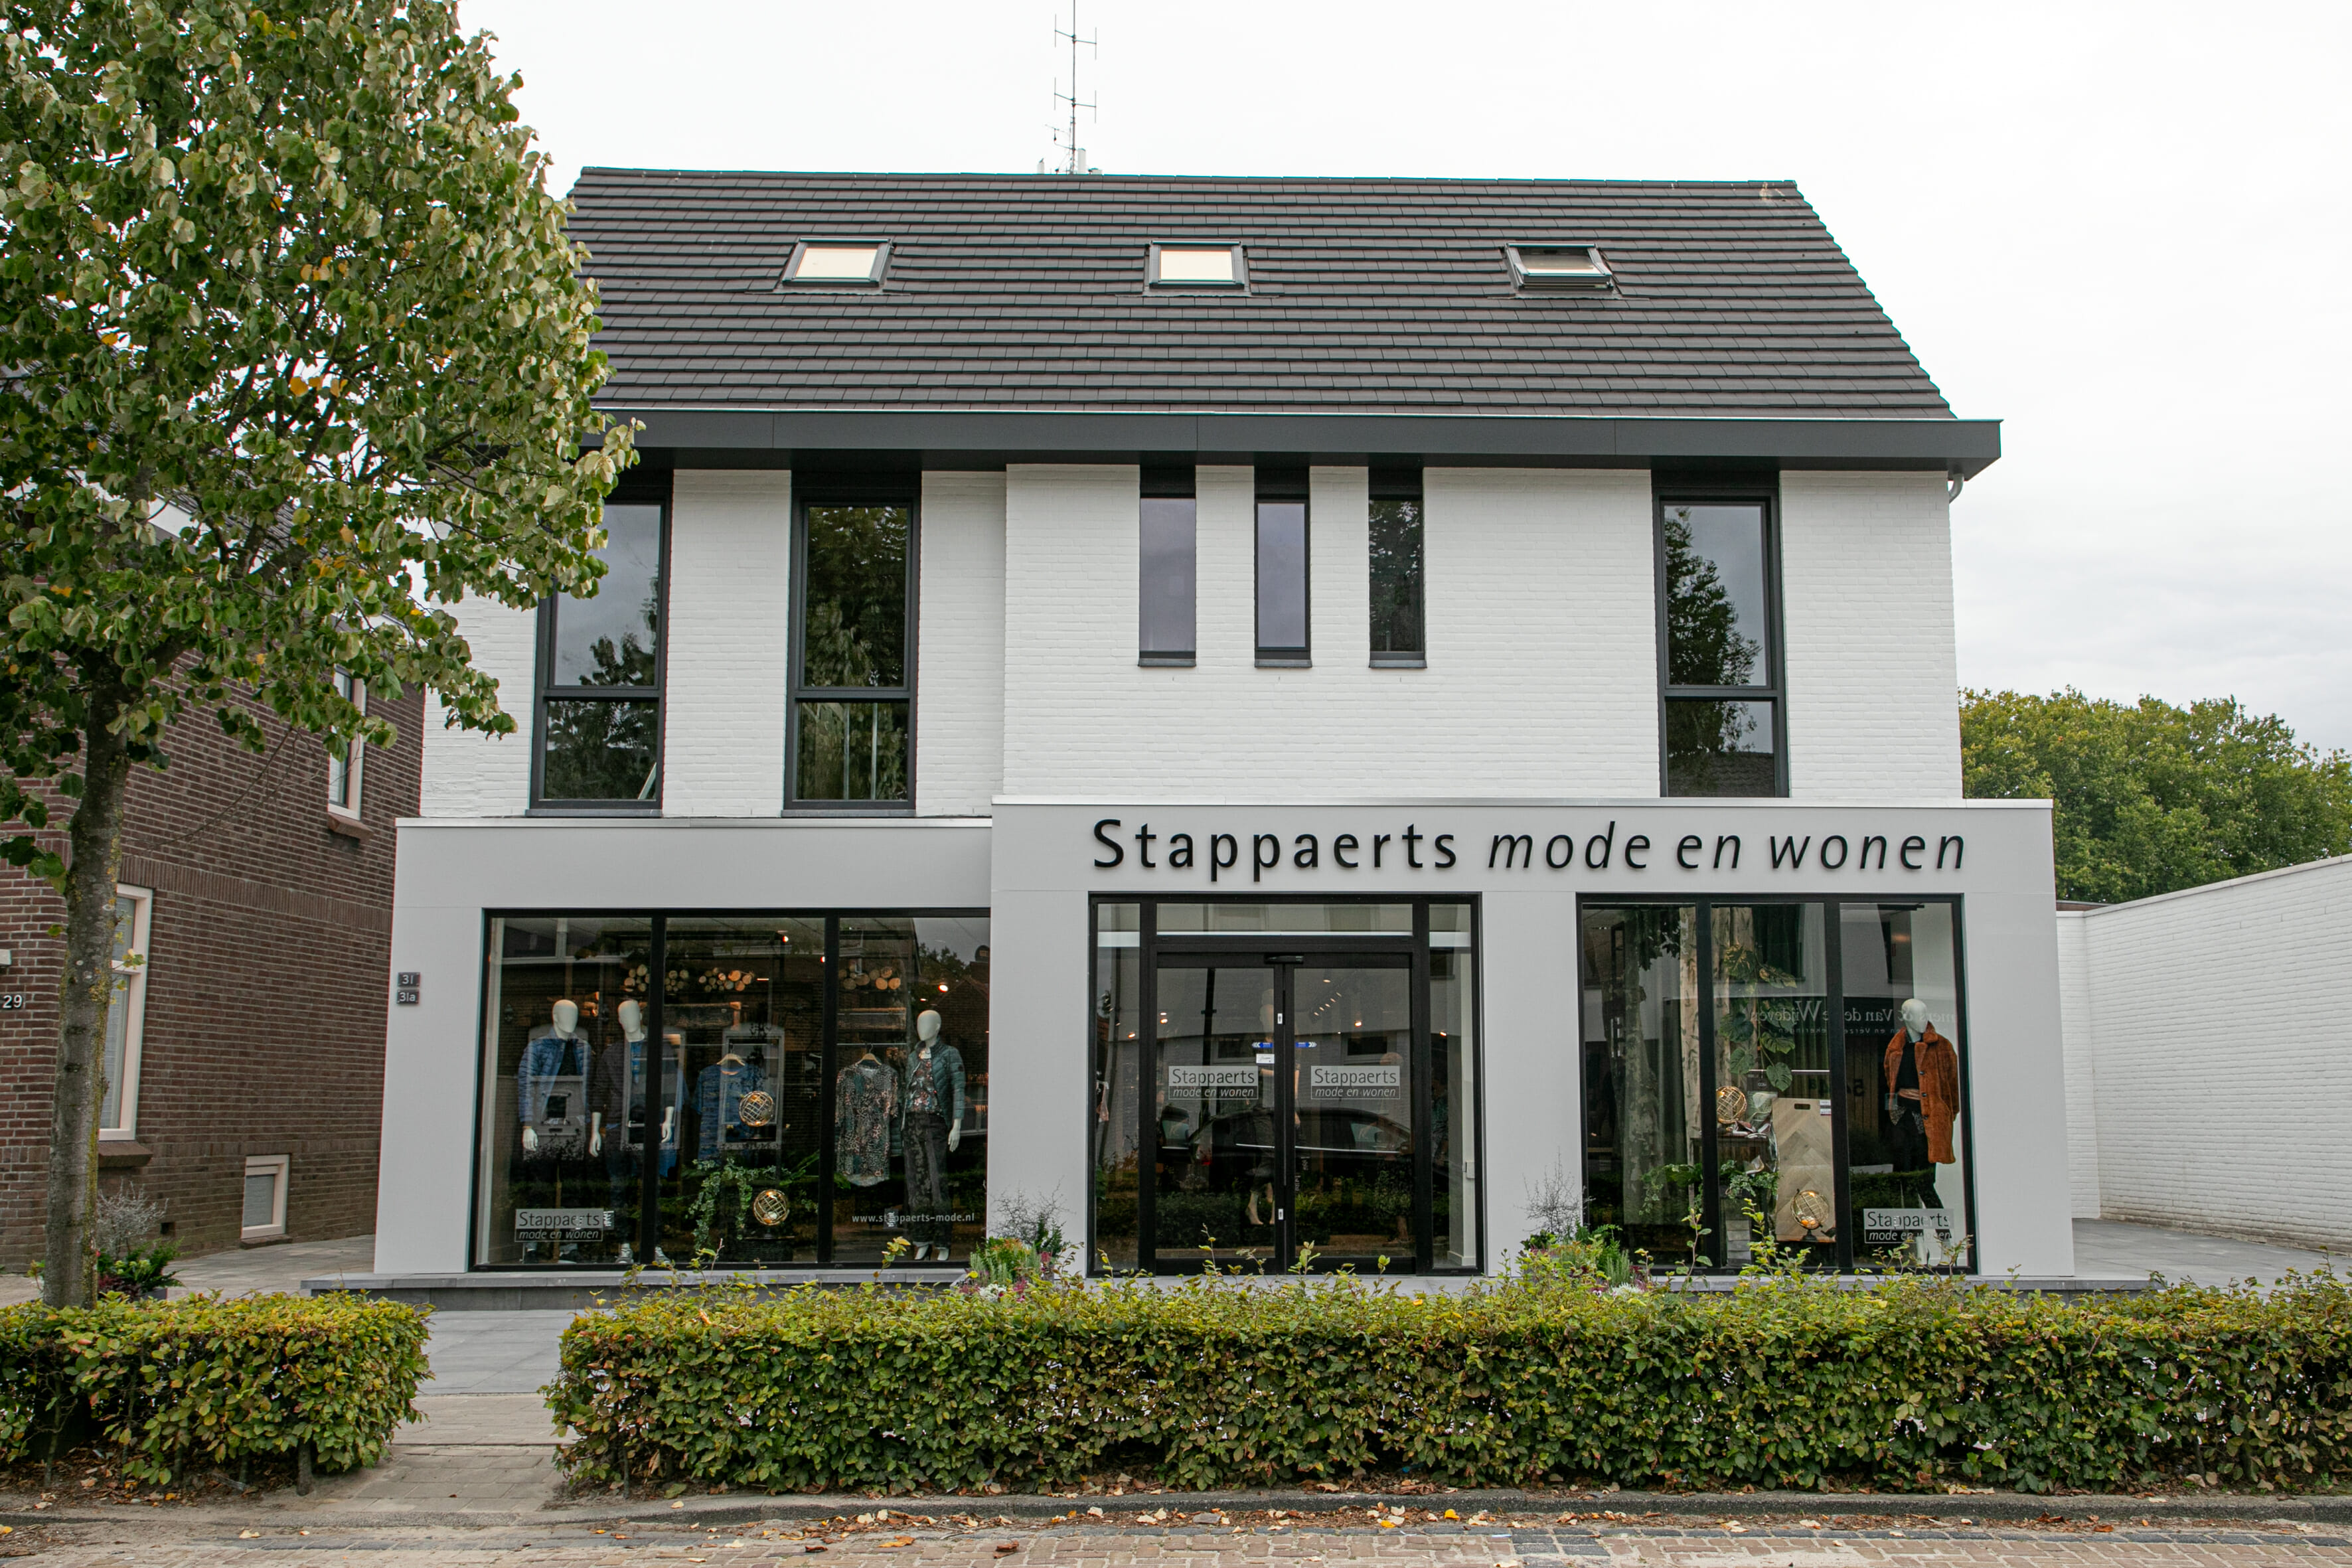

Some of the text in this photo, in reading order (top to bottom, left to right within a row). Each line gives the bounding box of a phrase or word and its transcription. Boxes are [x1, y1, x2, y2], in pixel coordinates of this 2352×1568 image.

[1093, 819, 1966, 883] Stappaerts mode en wonen
[402, 975, 414, 984] 31
[2, 994, 23, 1009] 29
[399, 992, 416, 1002] 31a
[1172, 1068, 1255, 1087] Stappaerts
[1314, 1068, 1397, 1087] Stappaerts
[1173, 1086, 1201, 1097] mode
[1315, 1086, 1344, 1097] mode
[852, 1213, 975, 1225] www.stppaerts-mode.nl
[519, 1229, 546, 1239] mode
[566, 1231, 599, 1239] wonen
[1869, 1229, 1897, 1241] mode
